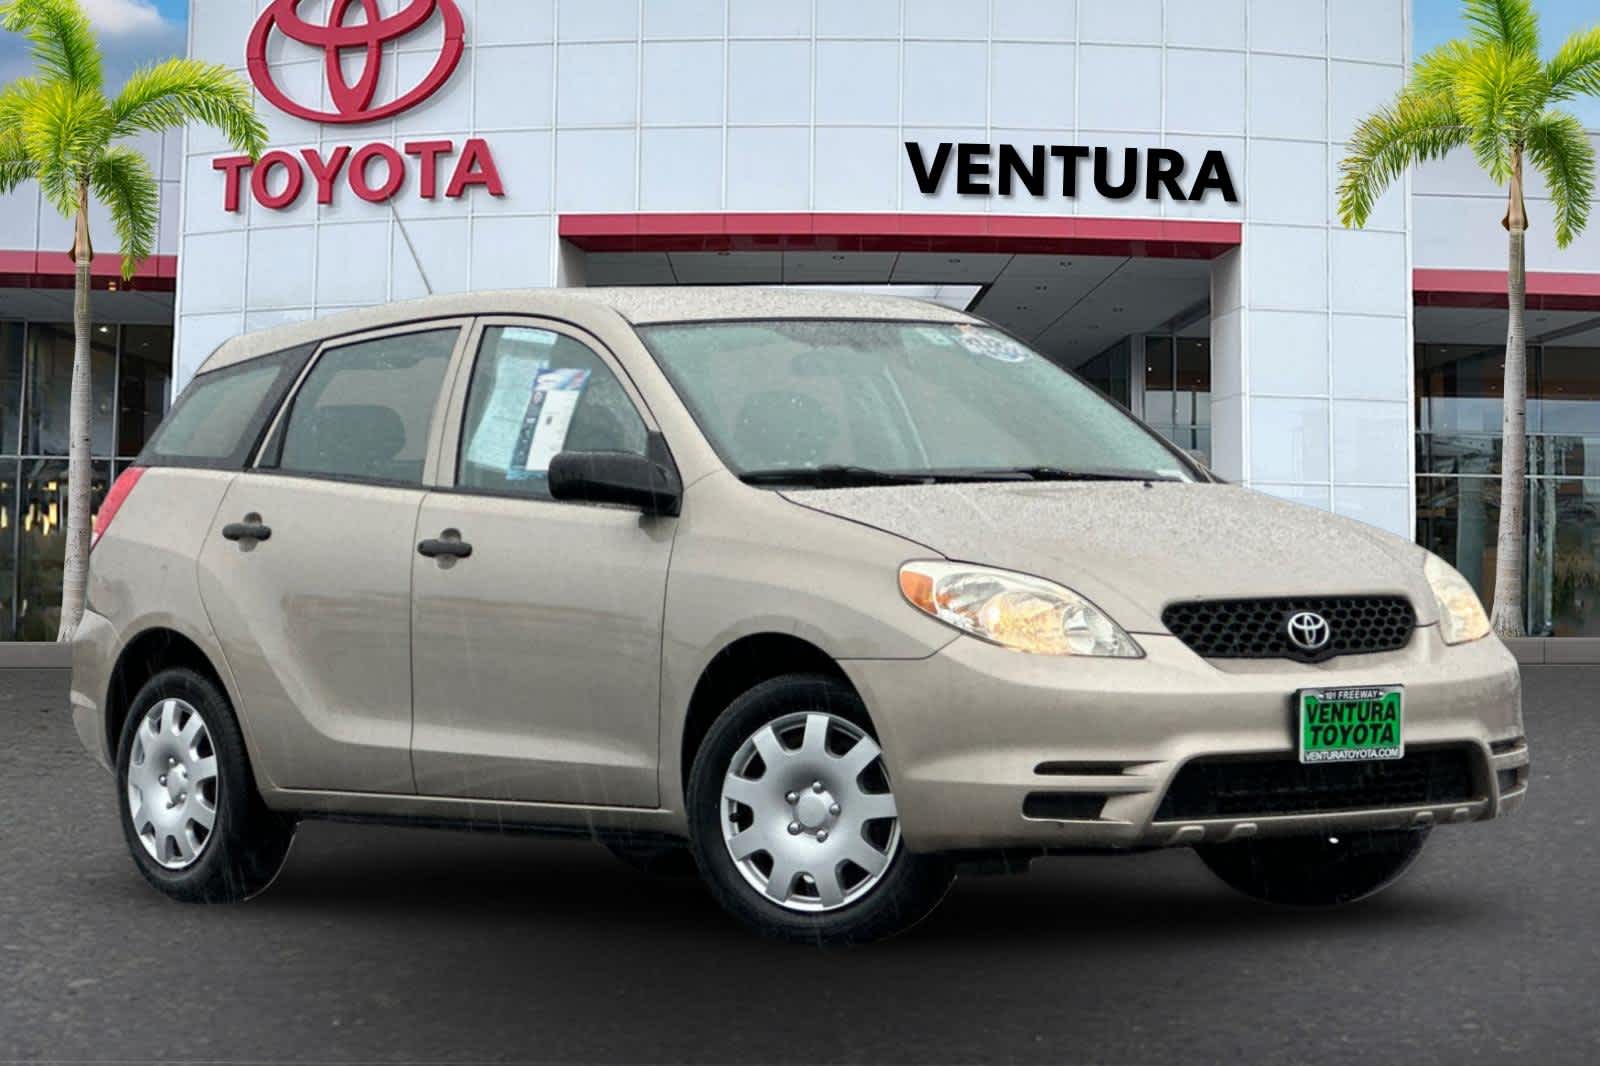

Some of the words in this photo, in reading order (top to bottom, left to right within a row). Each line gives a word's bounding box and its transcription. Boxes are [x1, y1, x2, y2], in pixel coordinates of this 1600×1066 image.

[213, 138, 505, 212] TOYOTA
[904, 141, 1237, 202] VENTURA
[1338, 690, 1377, 699] FREEWAY
[1306, 702, 1396, 723] VENTURA
[1311, 723, 1394, 746] TOYOTA
[1305, 749, 1399, 760] VENTURATOYOTA.COM
